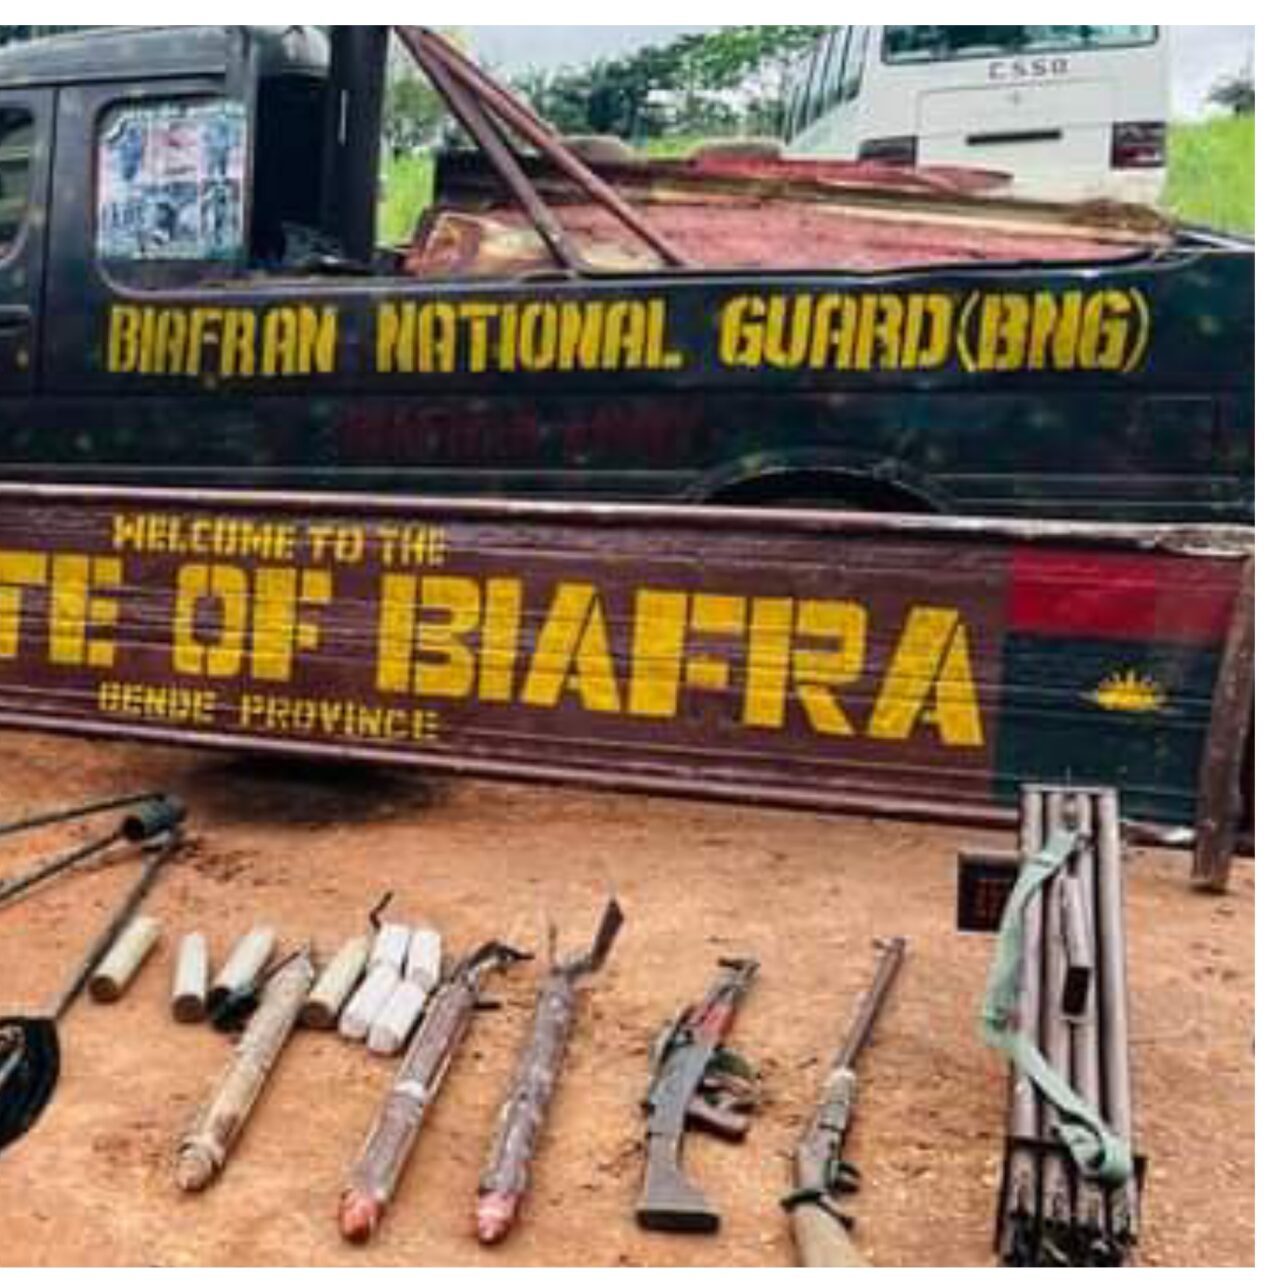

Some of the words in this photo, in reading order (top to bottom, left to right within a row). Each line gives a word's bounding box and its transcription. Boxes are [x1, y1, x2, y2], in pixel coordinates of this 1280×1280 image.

[107, 304, 338, 376] BIAFRAN
[375, 299, 683, 373] NATIONAL
[720, 287, 1150, 373] GUARD(BNG)
[112, 513, 296, 560] WELCOME
[308, 524, 365, 563] TO
[375, 524, 449, 565] THE
[170, 563, 333, 682] OF
[376, 572, 985, 747] BIAFRA
[239, 693, 440, 741] PROVINCE
